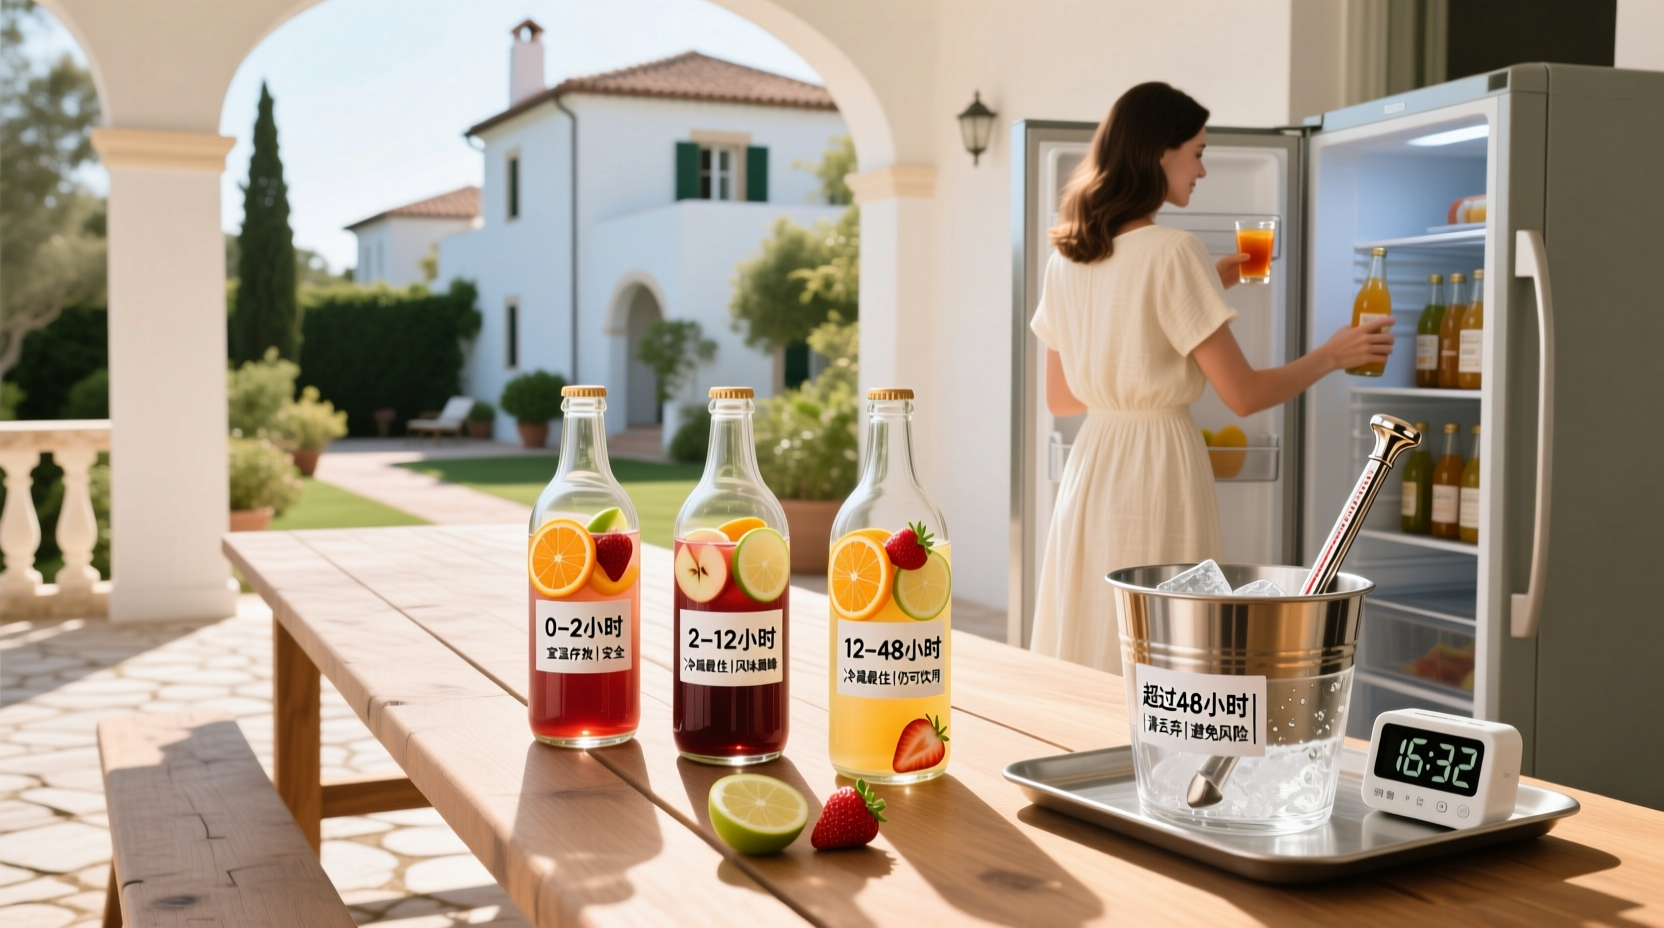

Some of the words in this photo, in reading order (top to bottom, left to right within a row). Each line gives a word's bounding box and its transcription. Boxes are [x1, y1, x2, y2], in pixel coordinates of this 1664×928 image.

[545, 615, 623, 639] 0-2小时
[688, 626, 776, 651] 2-12小时
[844, 635, 942, 661] 12-48小时
[1143, 682, 1249, 718] 超过48小时
[1396, 737, 1478, 789] 16:32
